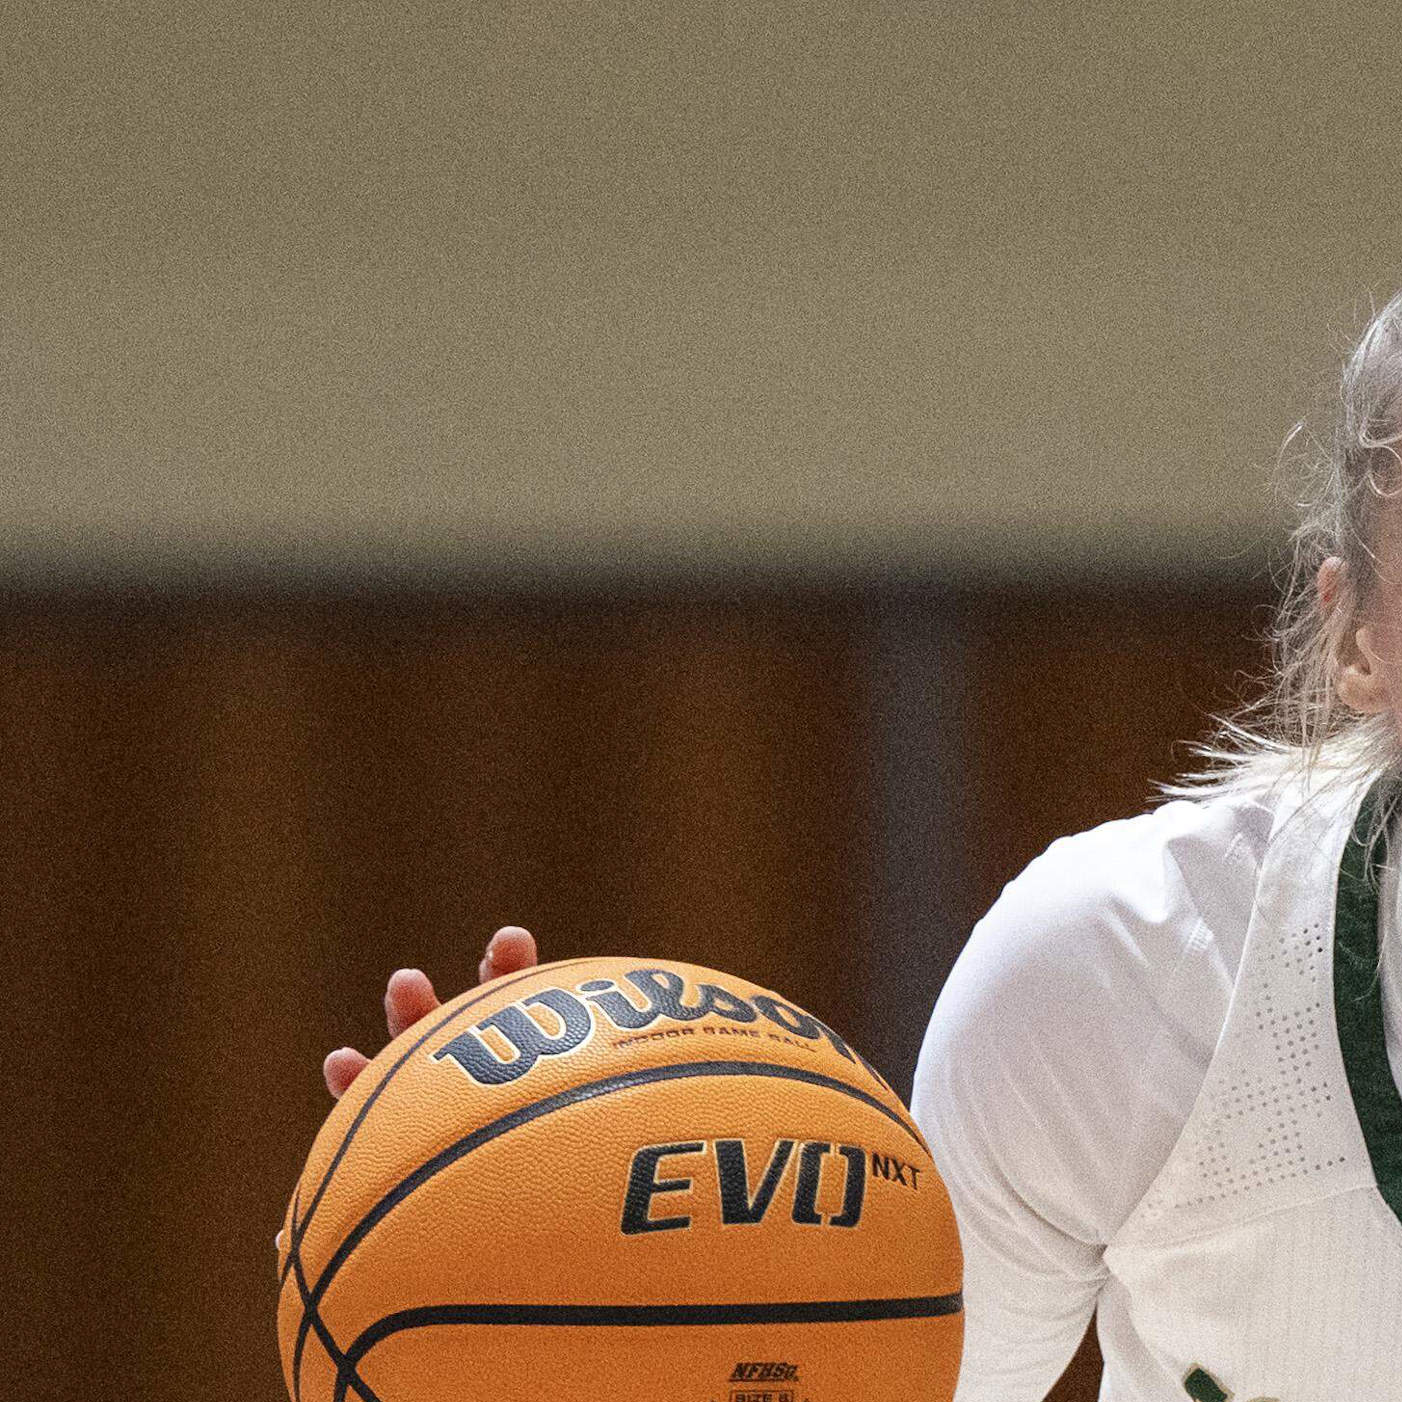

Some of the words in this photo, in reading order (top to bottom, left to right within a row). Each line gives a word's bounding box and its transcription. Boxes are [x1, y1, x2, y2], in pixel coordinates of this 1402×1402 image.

[611, 1026, 695, 1049] INDOOR
[703, 1026, 760, 1038] GAME
[767, 1033, 817, 1053] BALL
[620, 1138, 866, 1236] EVO
[871, 1152, 921, 1190] NXT
